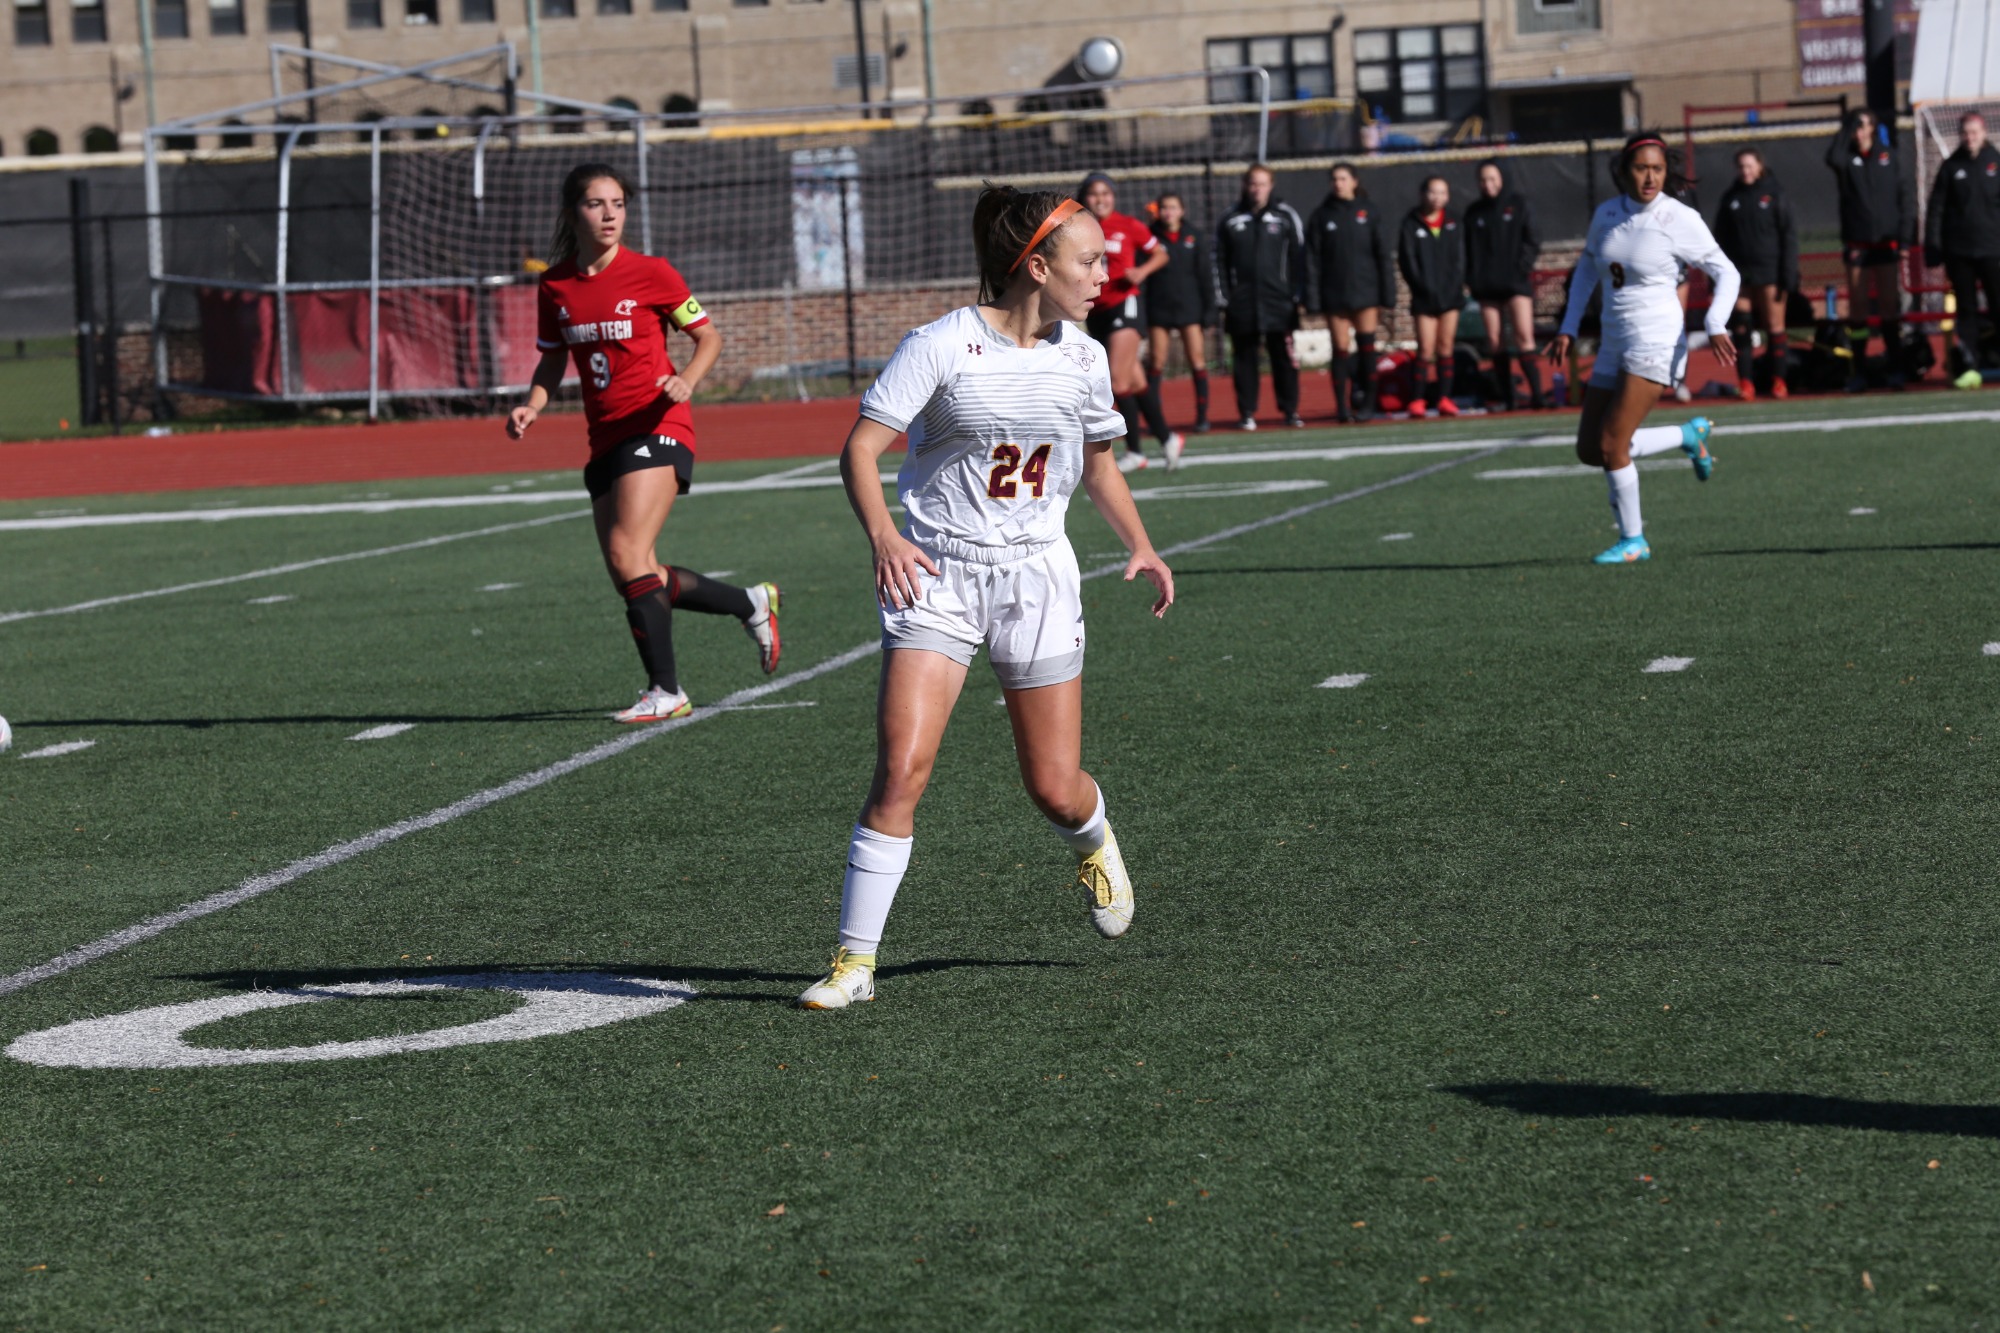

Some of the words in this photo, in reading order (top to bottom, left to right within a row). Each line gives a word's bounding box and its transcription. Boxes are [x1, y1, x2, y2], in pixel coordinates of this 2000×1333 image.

[1801, 62, 1867, 87] COUGAR
[1609, 261, 1625, 289] 9
[686, 301, 699, 315] C
[600, 319, 633, 341] TECH
[589, 351, 612, 390] 9
[986, 442, 1053, 499] 24
